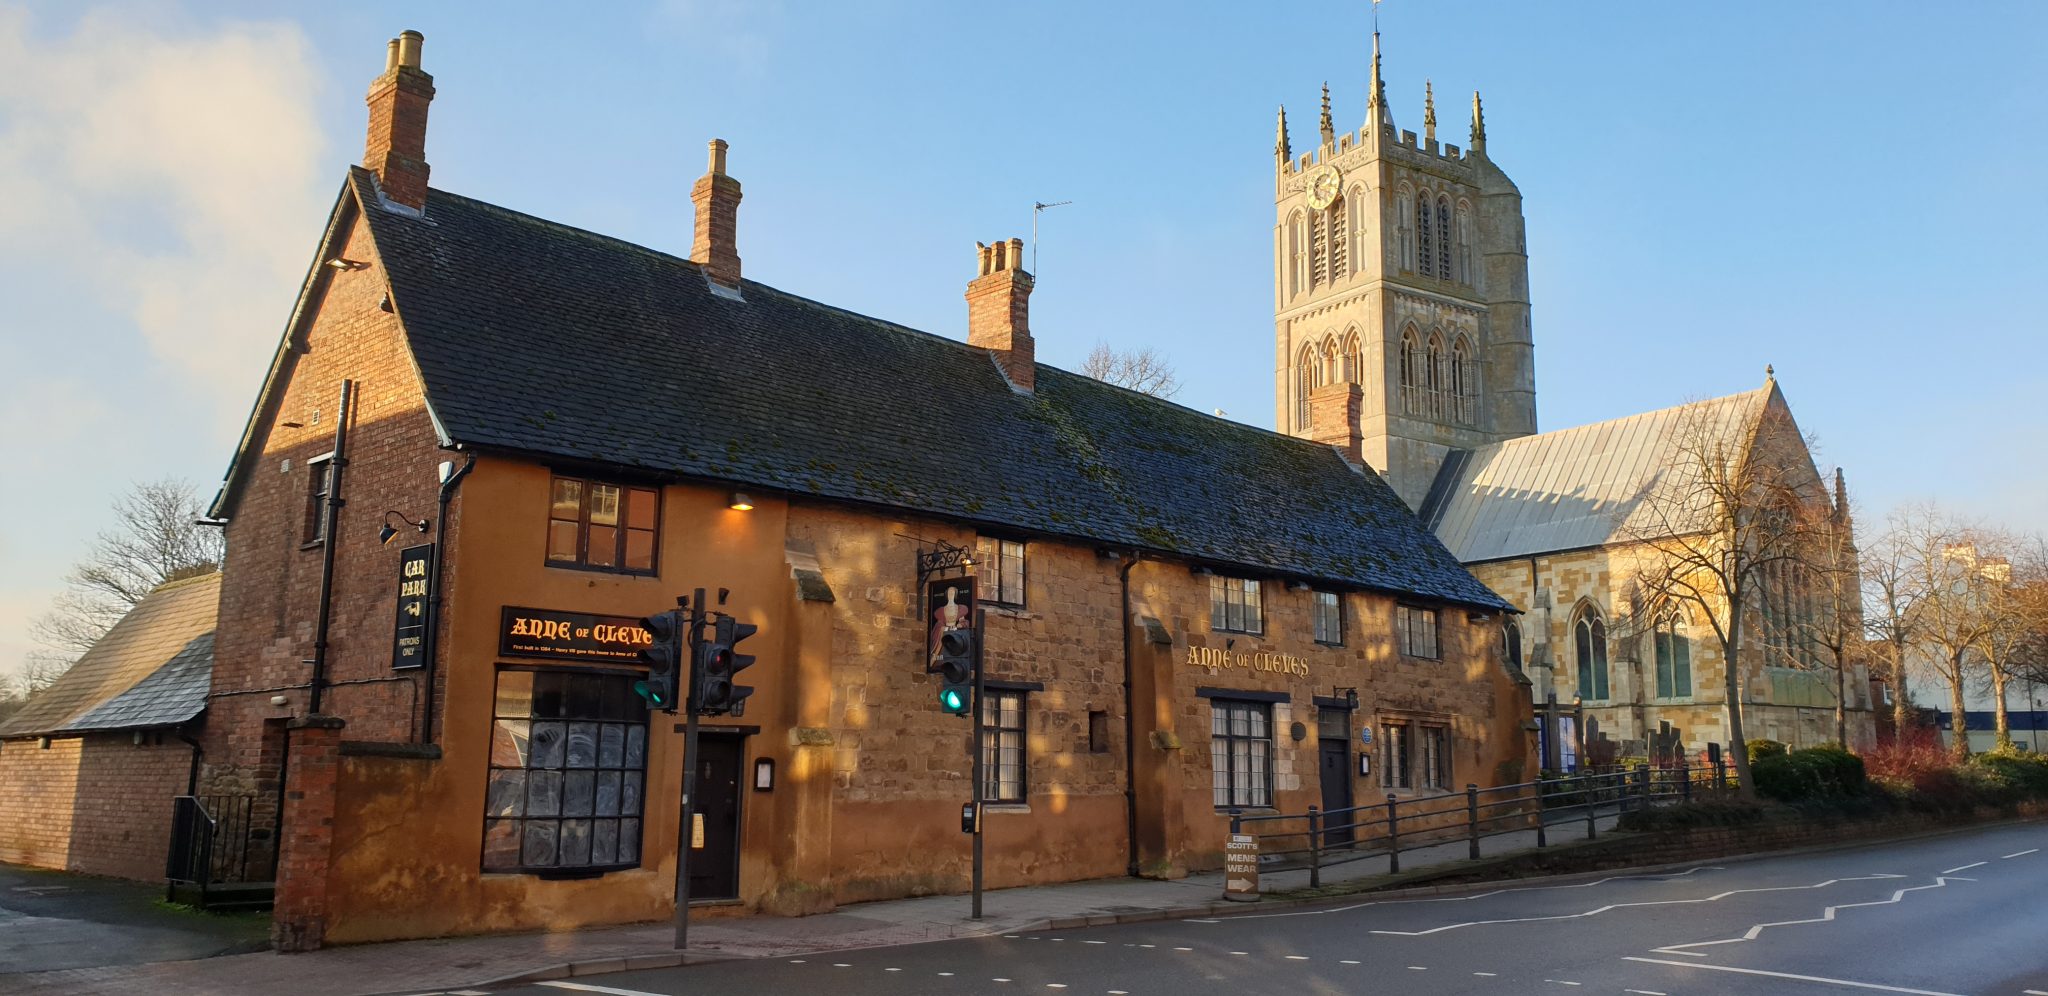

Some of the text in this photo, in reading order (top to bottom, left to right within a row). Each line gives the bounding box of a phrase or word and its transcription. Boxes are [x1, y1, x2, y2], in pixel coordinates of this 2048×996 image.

[404, 559, 425, 578] CAR
[401, 579, 426, 597] PARK
[510, 617, 653, 645] ANNE OF CLEVE
[399, 636, 420, 646] PATRONS
[403, 647, 415, 656] ONLY
[1186, 644, 1309, 679] ANNE OF CLEVES
[1226, 842, 1258, 850] SCOTT'S
[1227, 853, 1257, 862] MENS
[1227, 864, 1257, 873] WEAR
